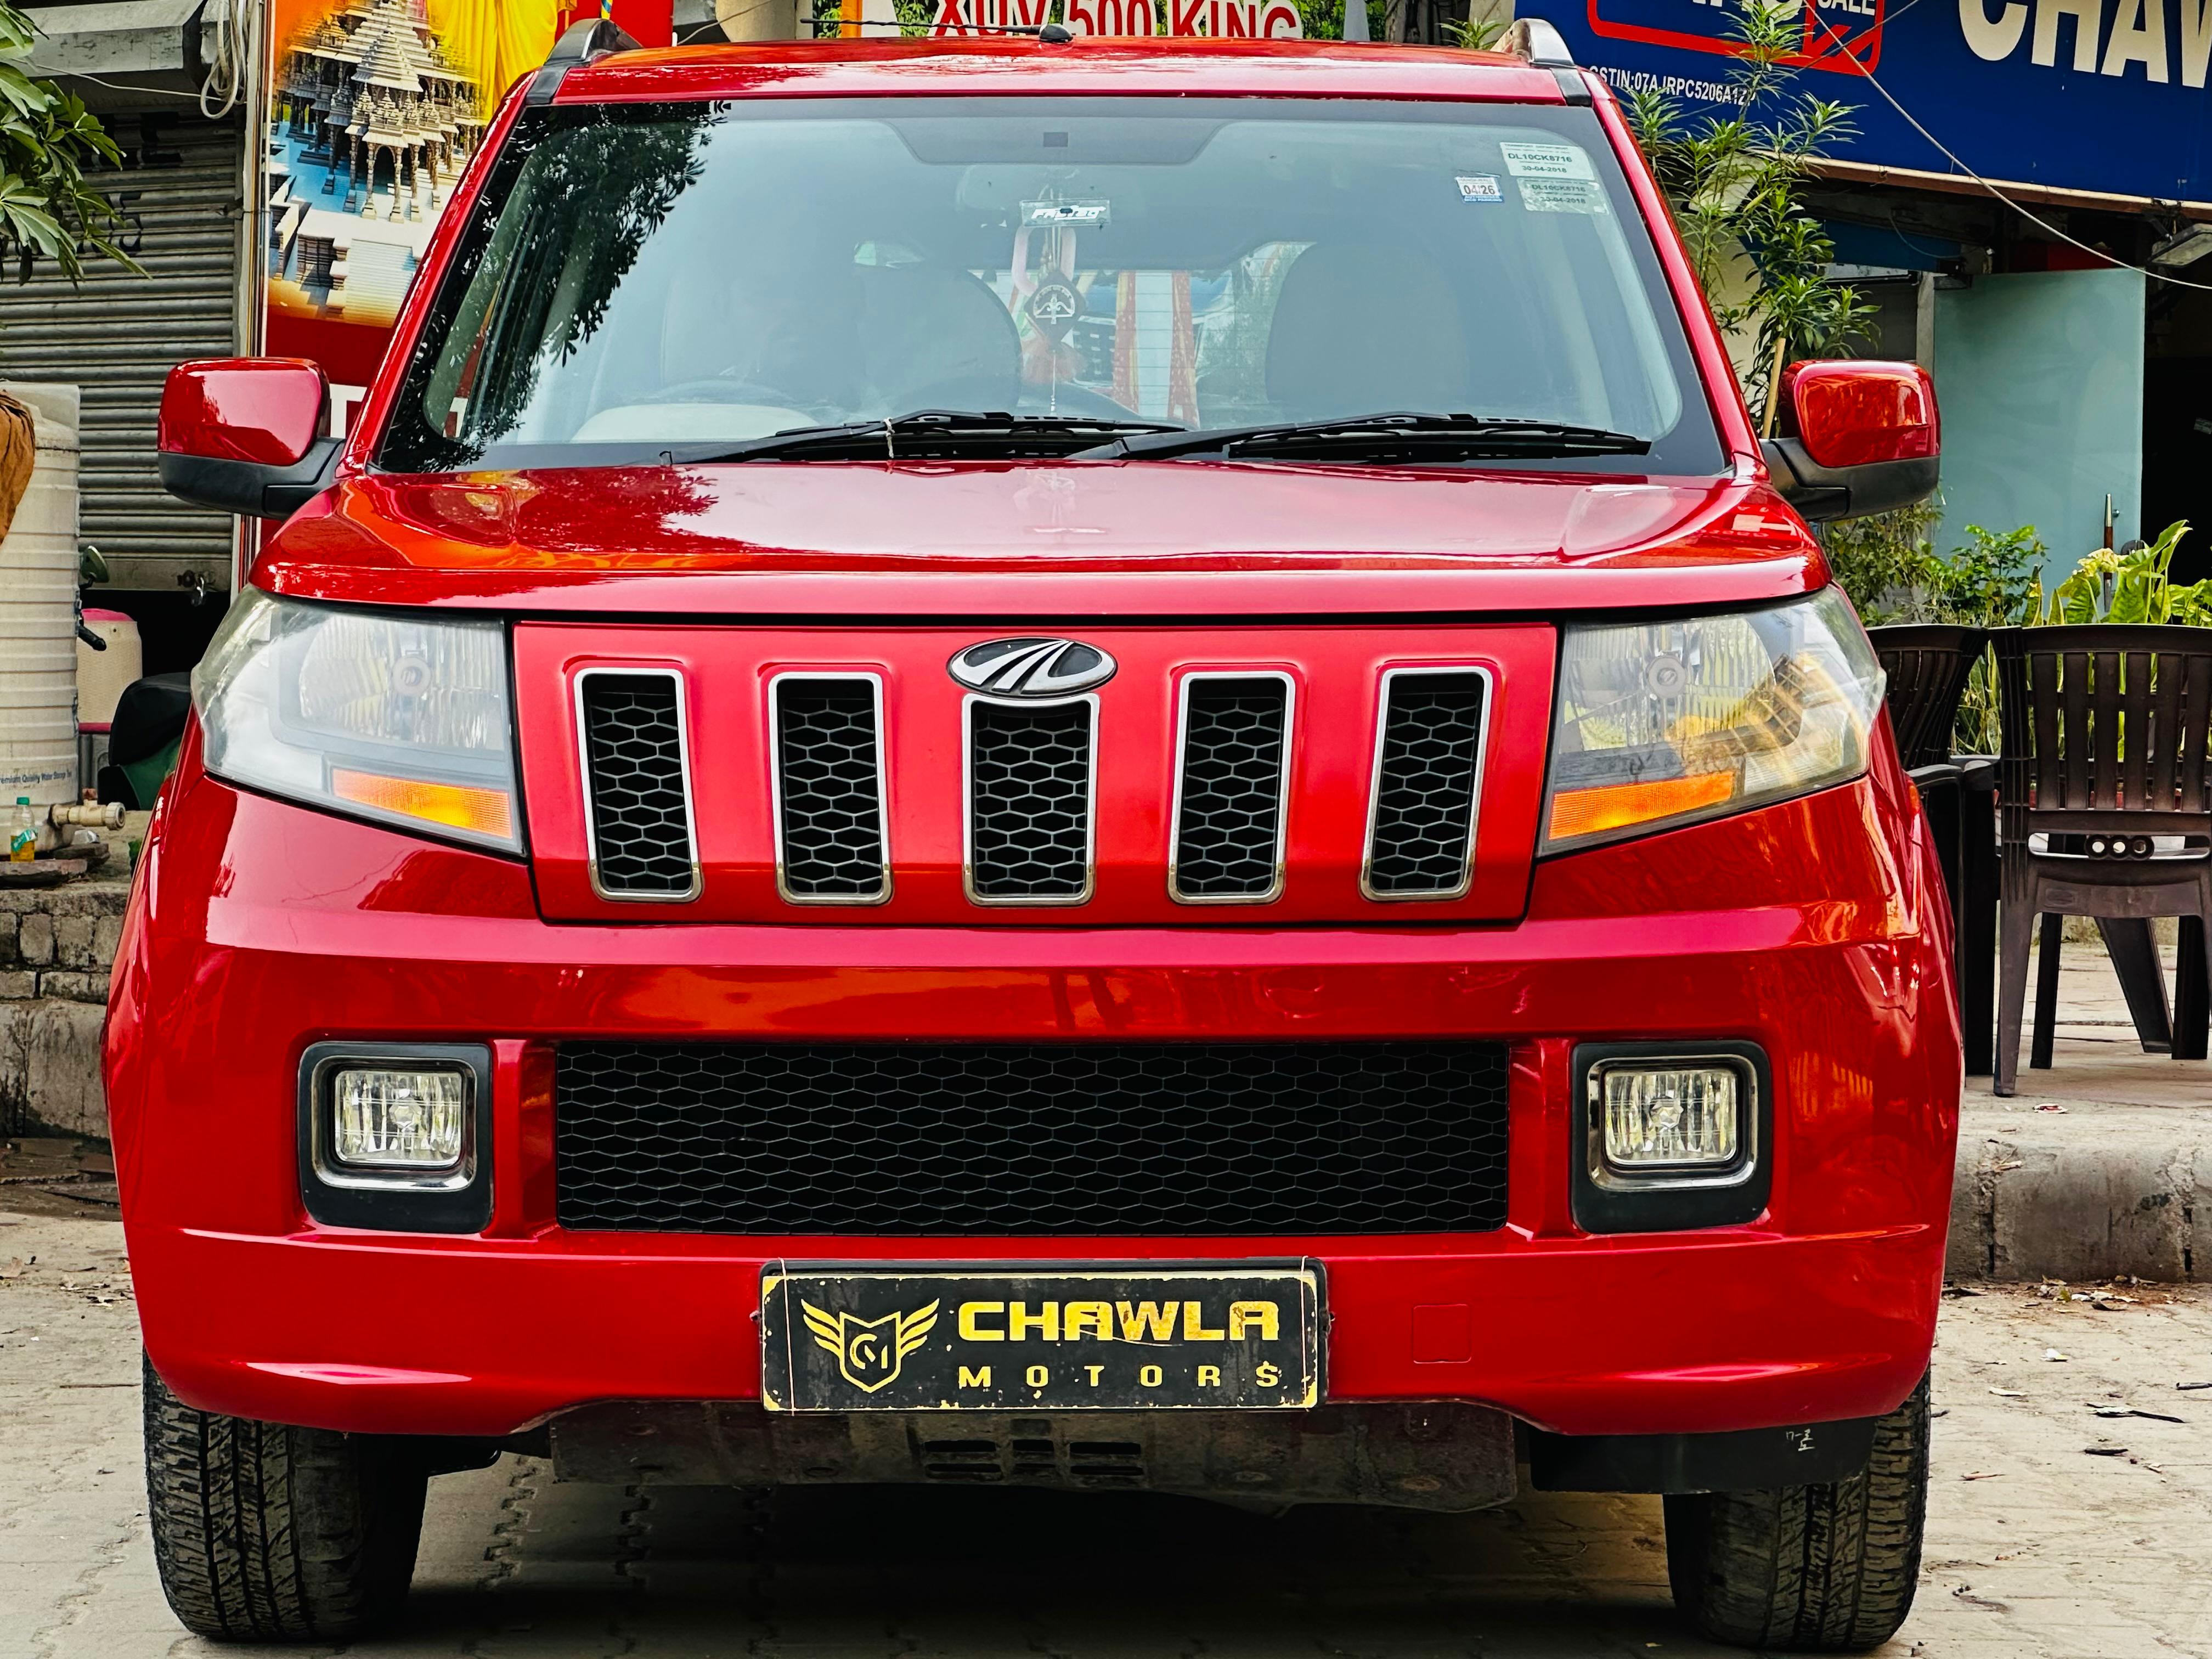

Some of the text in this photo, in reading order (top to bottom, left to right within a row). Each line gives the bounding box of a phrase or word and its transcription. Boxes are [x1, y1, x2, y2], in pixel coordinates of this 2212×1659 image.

[1069, 0, 1151, 36] 500
[958, 1300, 1279, 1341] CHAWLA
[958, 1365, 1279, 1387] MOTORS
